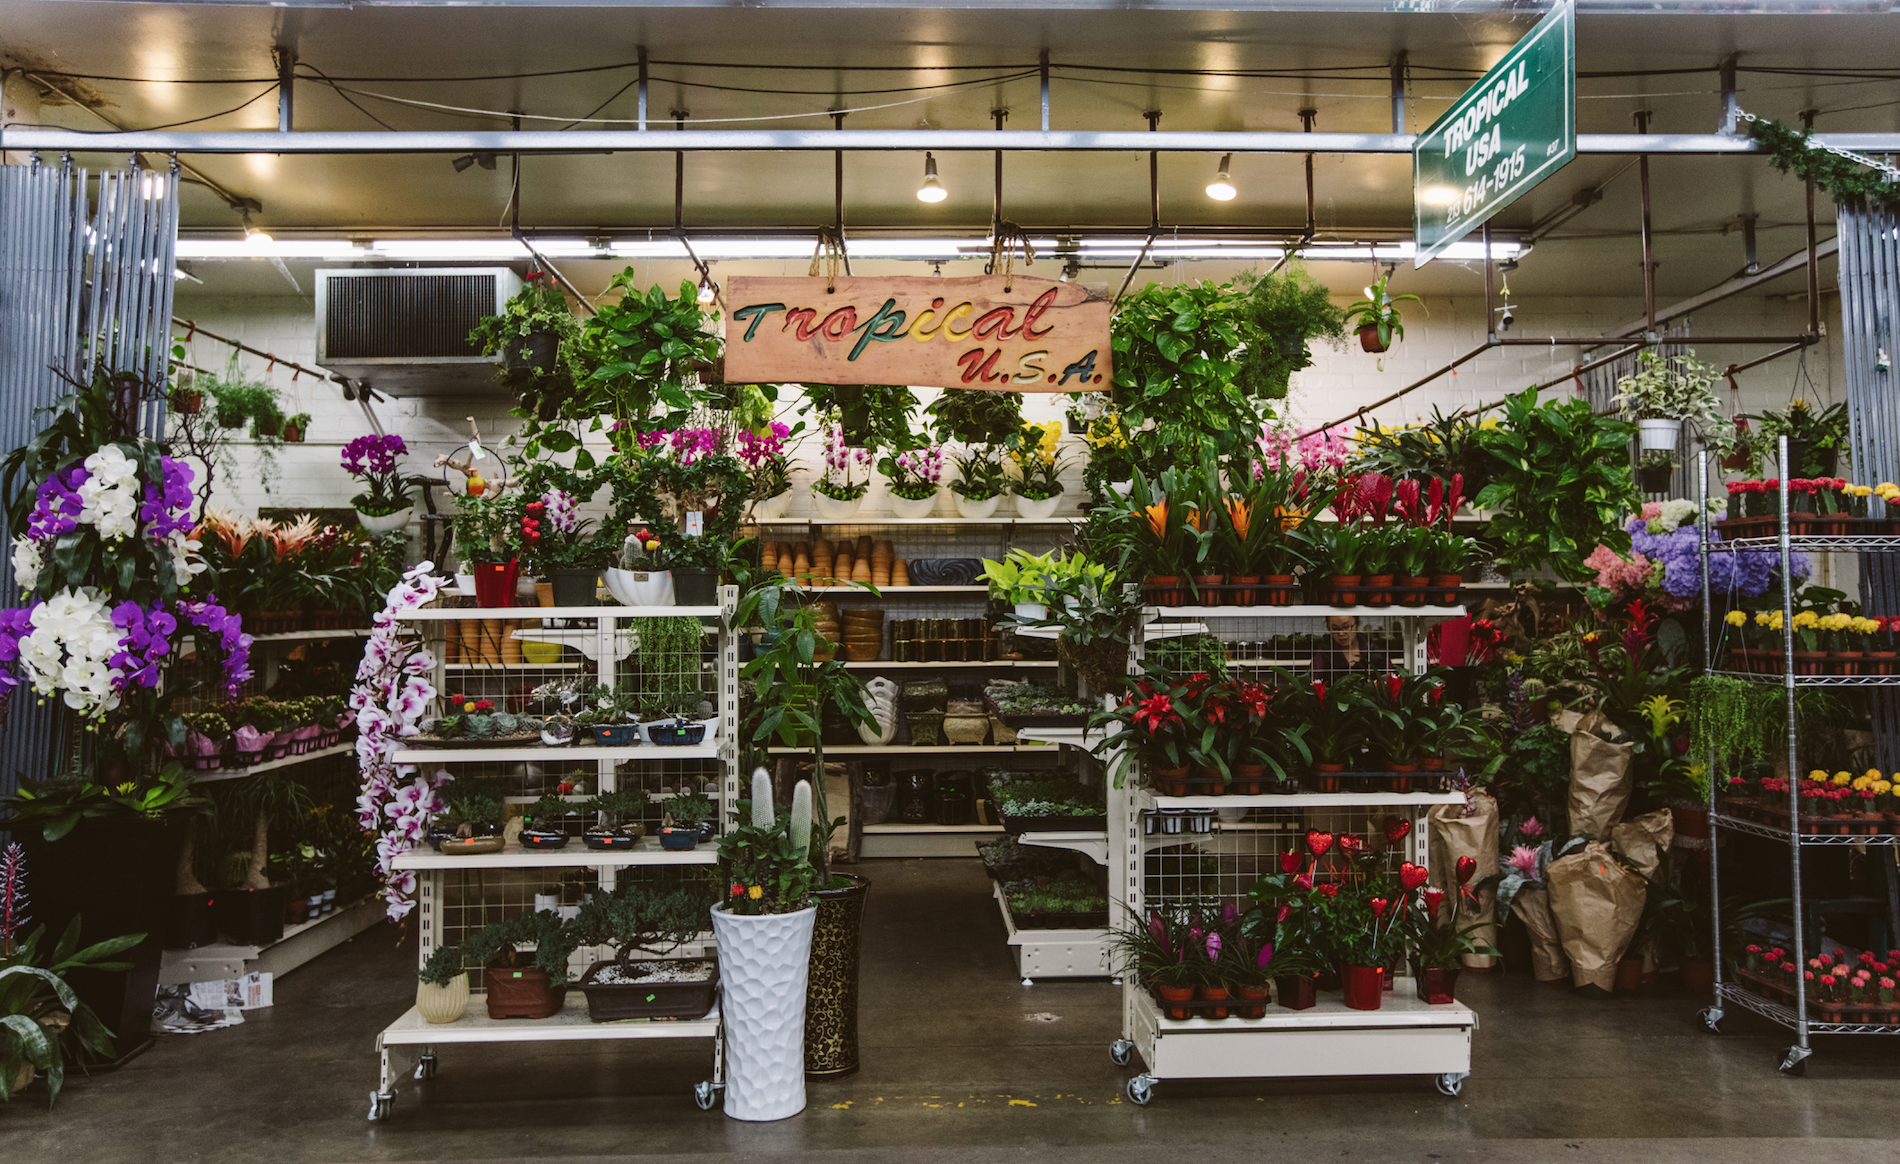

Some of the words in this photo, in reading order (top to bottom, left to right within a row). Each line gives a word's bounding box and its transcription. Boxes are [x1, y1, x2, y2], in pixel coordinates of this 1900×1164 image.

[1443, 60, 1529, 159] TROPICAL
[1446, 200, 1461, 224] 213
[1463, 144, 1526, 216] 614-1915
[1465, 123, 1501, 177] USA
[733, 286, 1059, 362] Tropical
[957, 347, 1103, 387] U.S.A.
